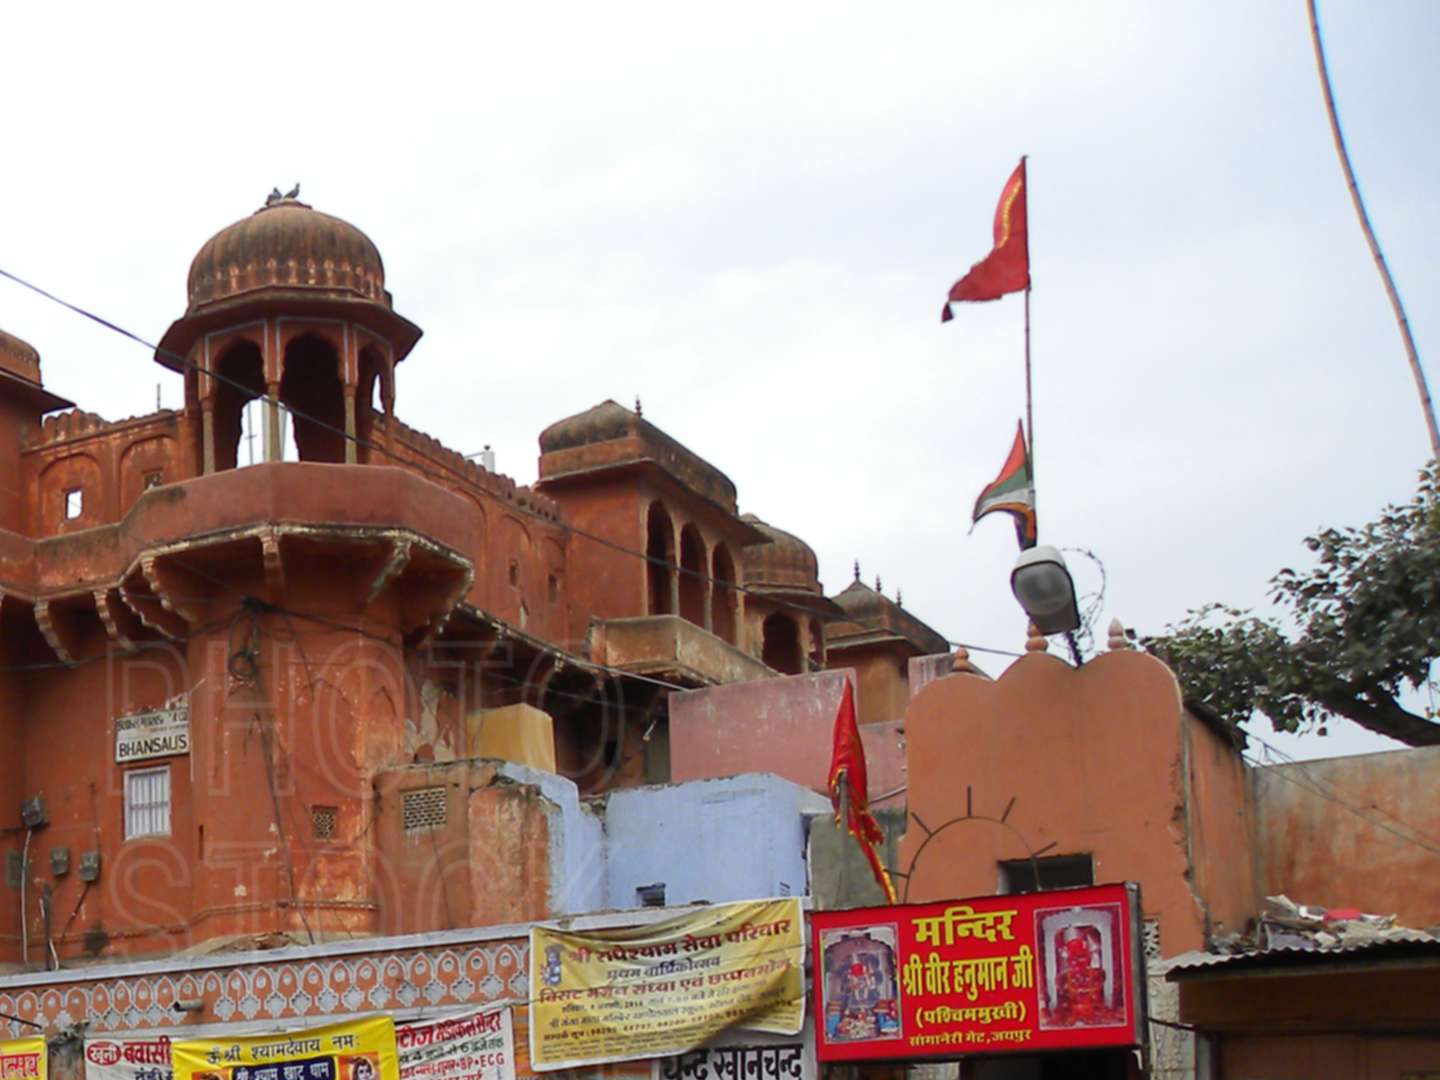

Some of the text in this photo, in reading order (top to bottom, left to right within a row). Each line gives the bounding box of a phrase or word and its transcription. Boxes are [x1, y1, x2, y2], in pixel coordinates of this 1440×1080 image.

[568, 945, 591, 965] श्री
[682, 933, 722, 952] सेवा
[725, 918, 792, 943] परिवार
[912, 906, 1018, 946] मन्दिर
[632, 978, 676, 997] संध्या
[903, 945, 1033, 1001] श्री वीर हनुमान जी
[123, 1034, 173, 1065] बवासी
[224, 1043, 241, 1063] श्री
[251, 1036, 321, 1060] श्यामदेवाय
[910, 1031, 963, 1047] सांगानेरी
